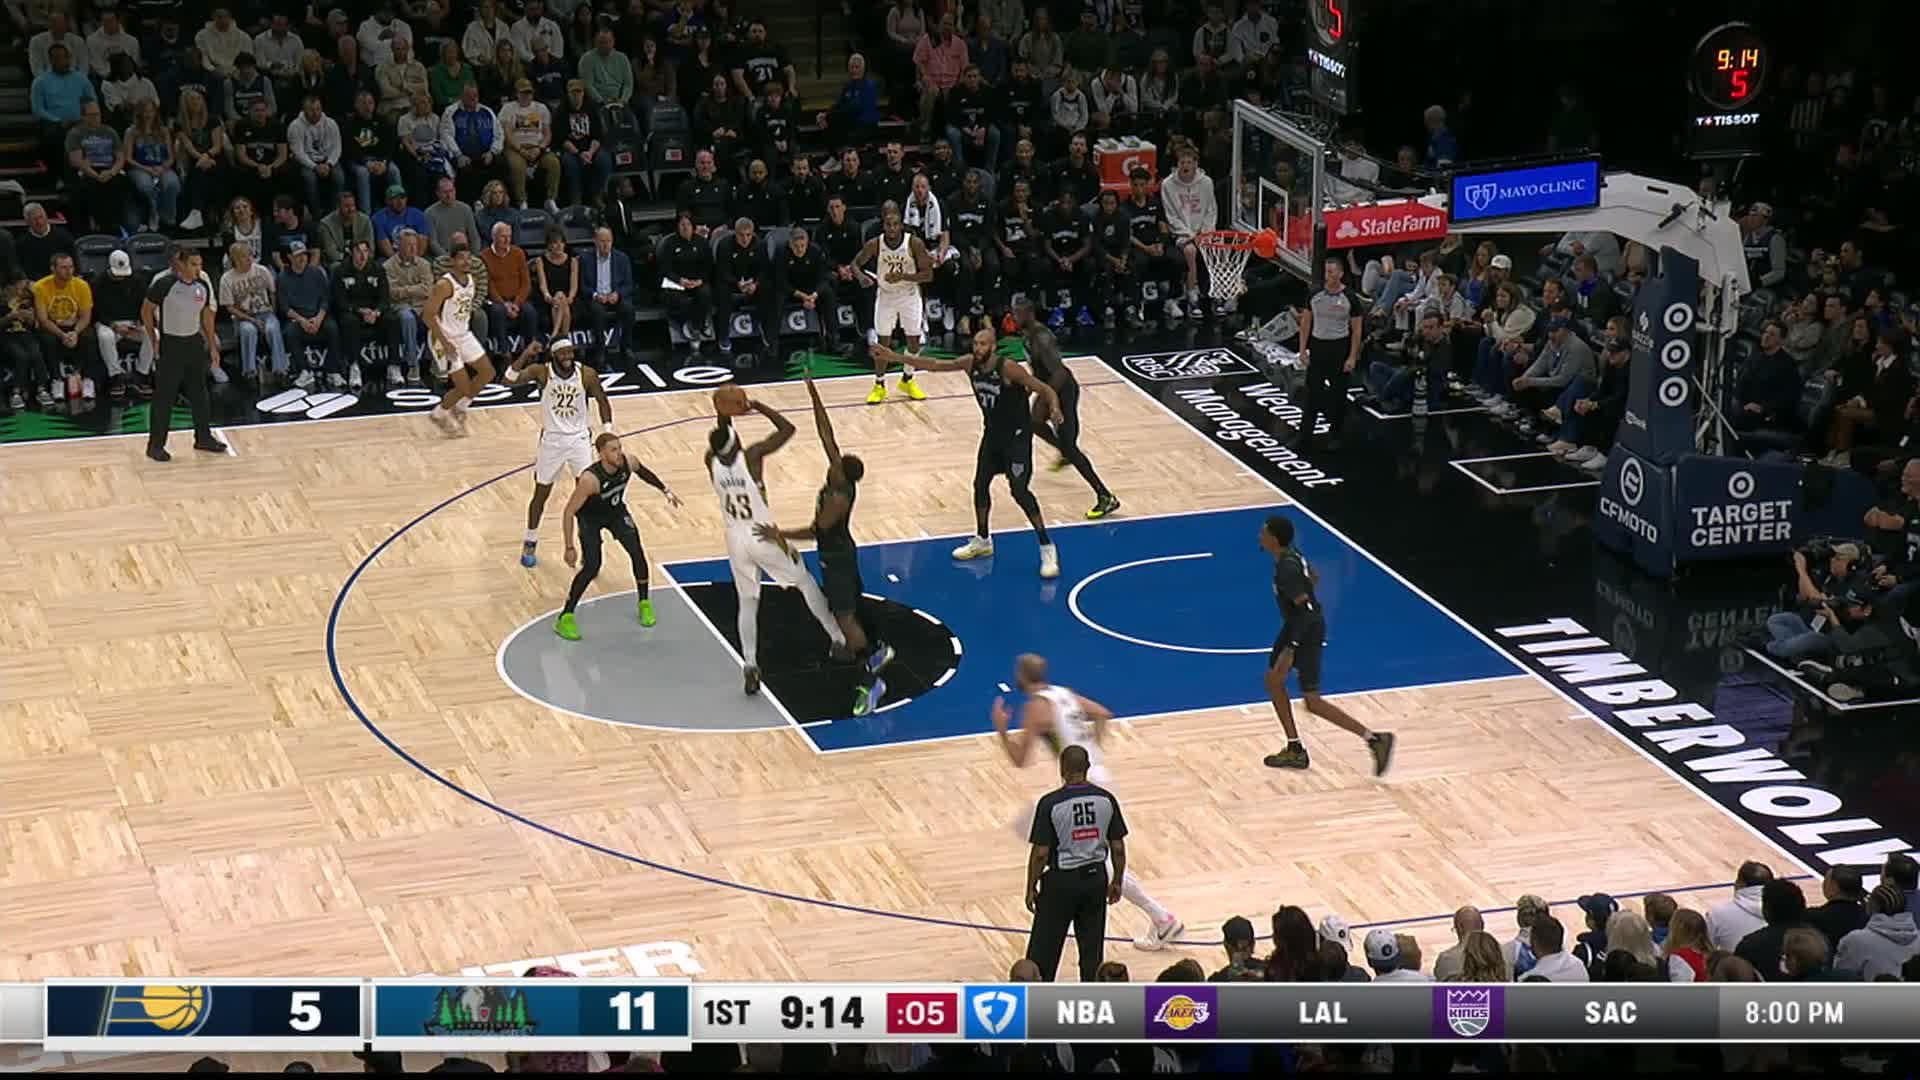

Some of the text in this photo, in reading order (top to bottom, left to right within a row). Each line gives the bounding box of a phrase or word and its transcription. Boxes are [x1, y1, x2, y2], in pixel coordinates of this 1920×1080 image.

[1718, 49, 1759, 70] 9:14
[1731, 70, 1748, 97] 5
[1500, 179, 1586, 199] MAYO CLINIC
[733, 314, 753, 334] G
[787, 310, 807, 331] G
[556, 393, 574, 408] 22
[1175, 387, 1345, 488] Management
[726, 493, 753, 519] 43
[1691, 500, 1793, 526] TARGET
[1600, 496, 1658, 544] CFMOTO
[1691, 521, 1792, 547] CENTER
[1073, 802, 1096, 826] 25
